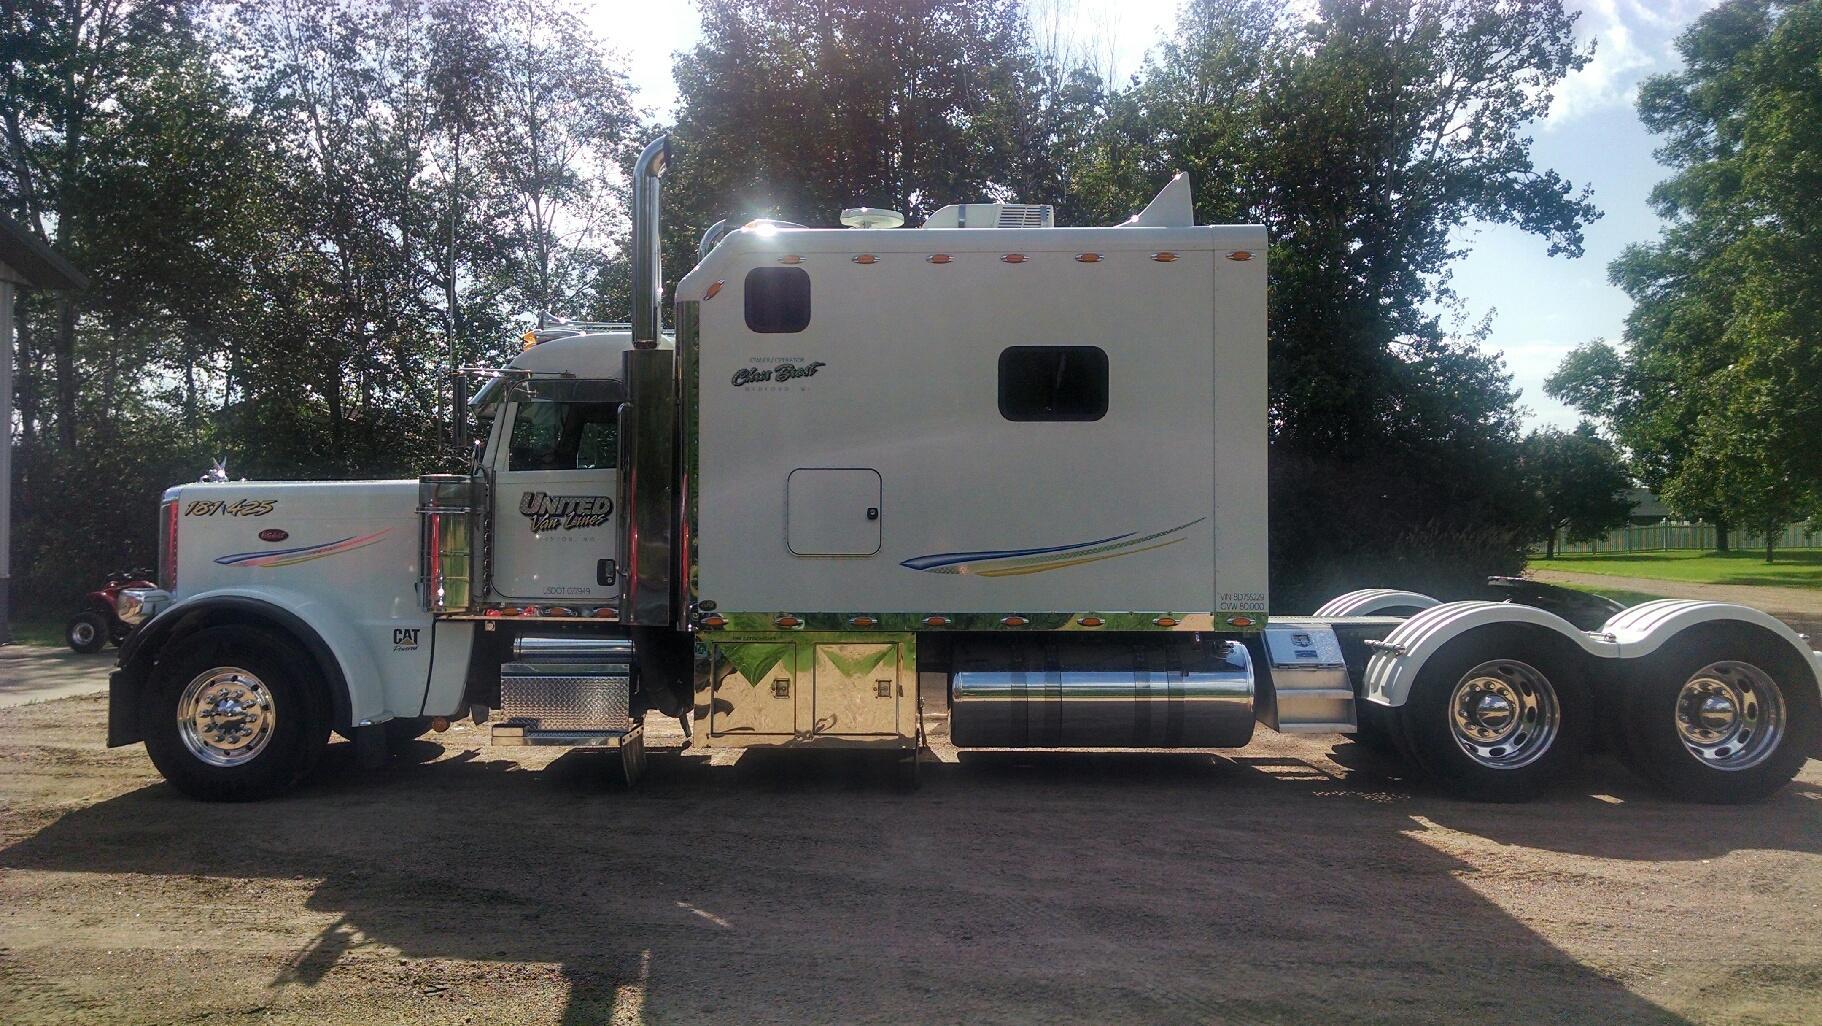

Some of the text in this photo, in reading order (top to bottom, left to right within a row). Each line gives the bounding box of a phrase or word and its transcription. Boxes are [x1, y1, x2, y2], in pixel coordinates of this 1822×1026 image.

[519, 491, 614, 518] UNITED
[530, 511, 609, 534] Van Lines
[393, 628, 420, 645] CAT
